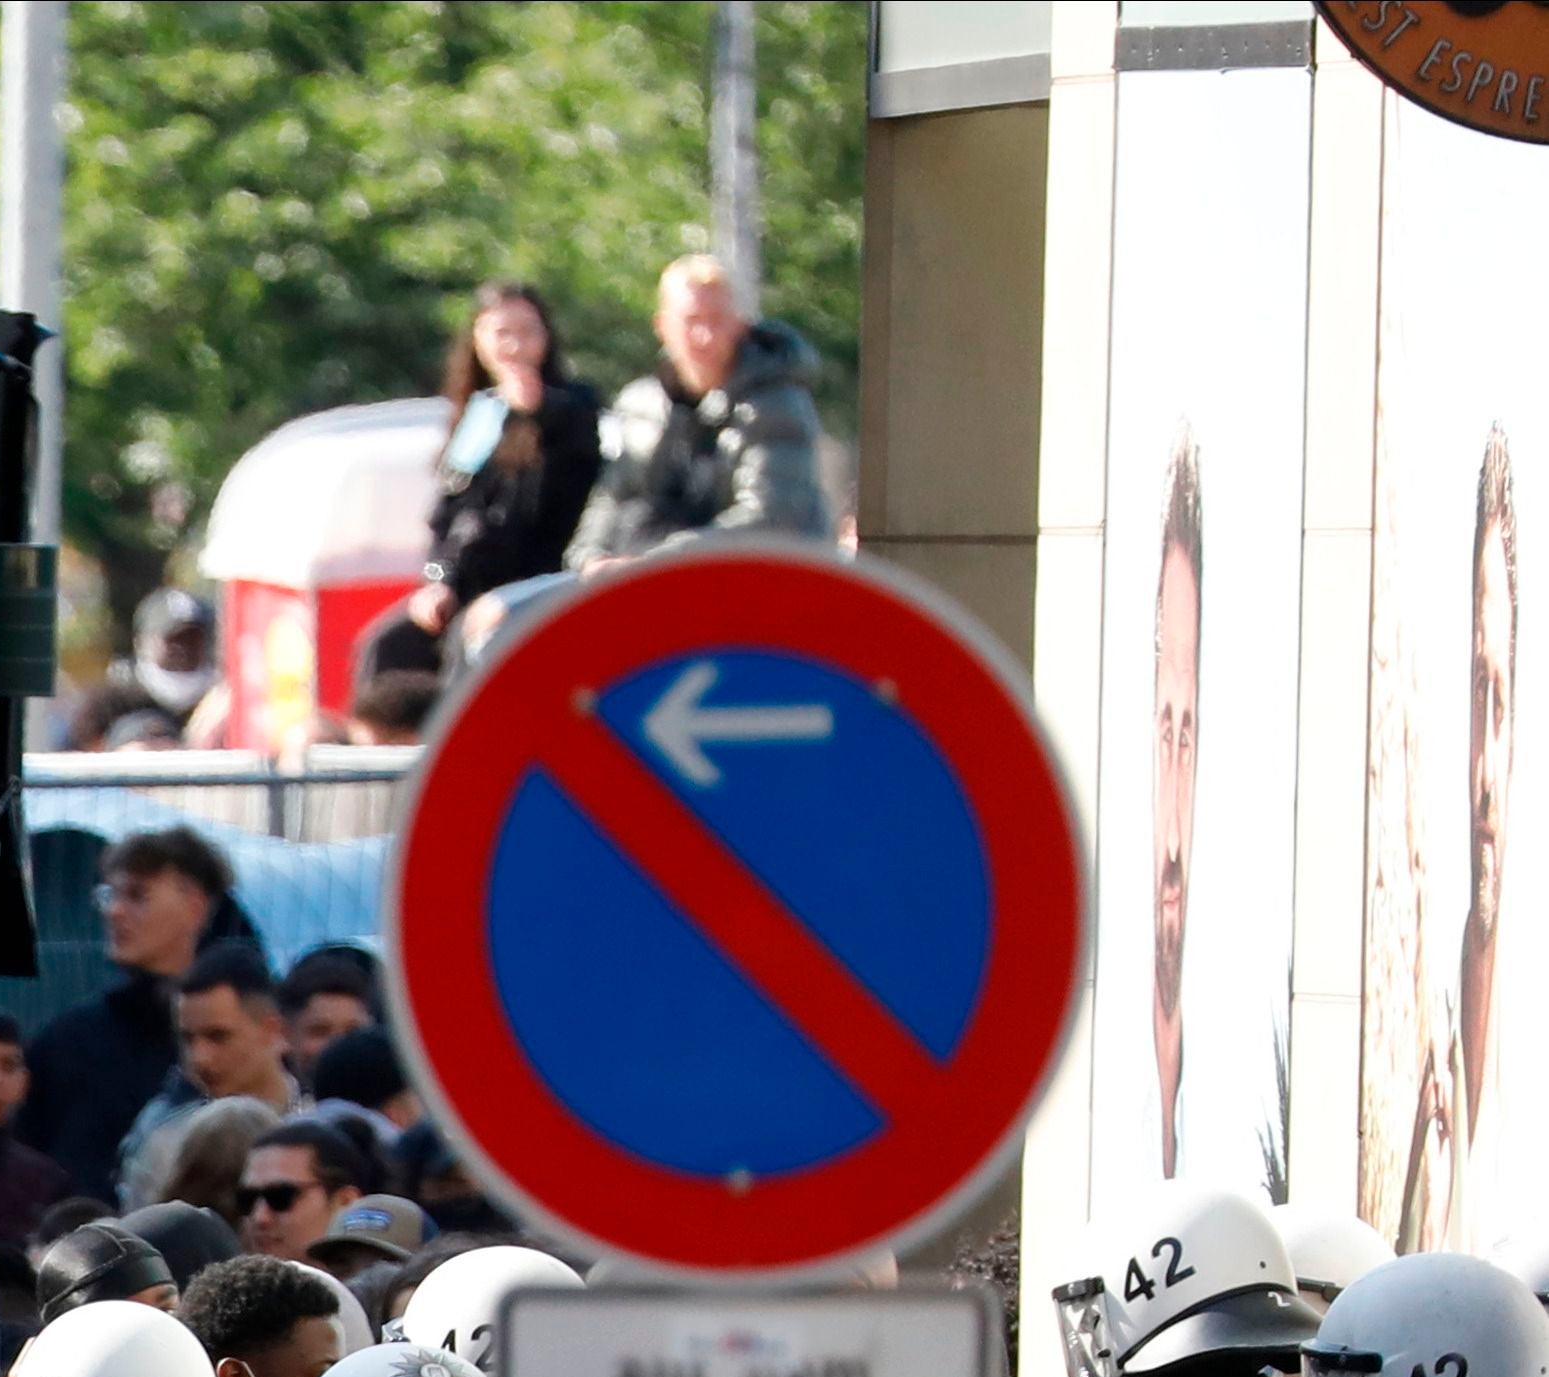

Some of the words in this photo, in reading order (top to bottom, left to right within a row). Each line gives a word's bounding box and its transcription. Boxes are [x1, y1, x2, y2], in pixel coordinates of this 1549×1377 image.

[1346, 0, 1421, 47] ST
[1417, 38, 1544, 119] ESPRE
[1124, 1237, 1196, 1303] 42
[1267, 1291, 1291, 1308] 2
